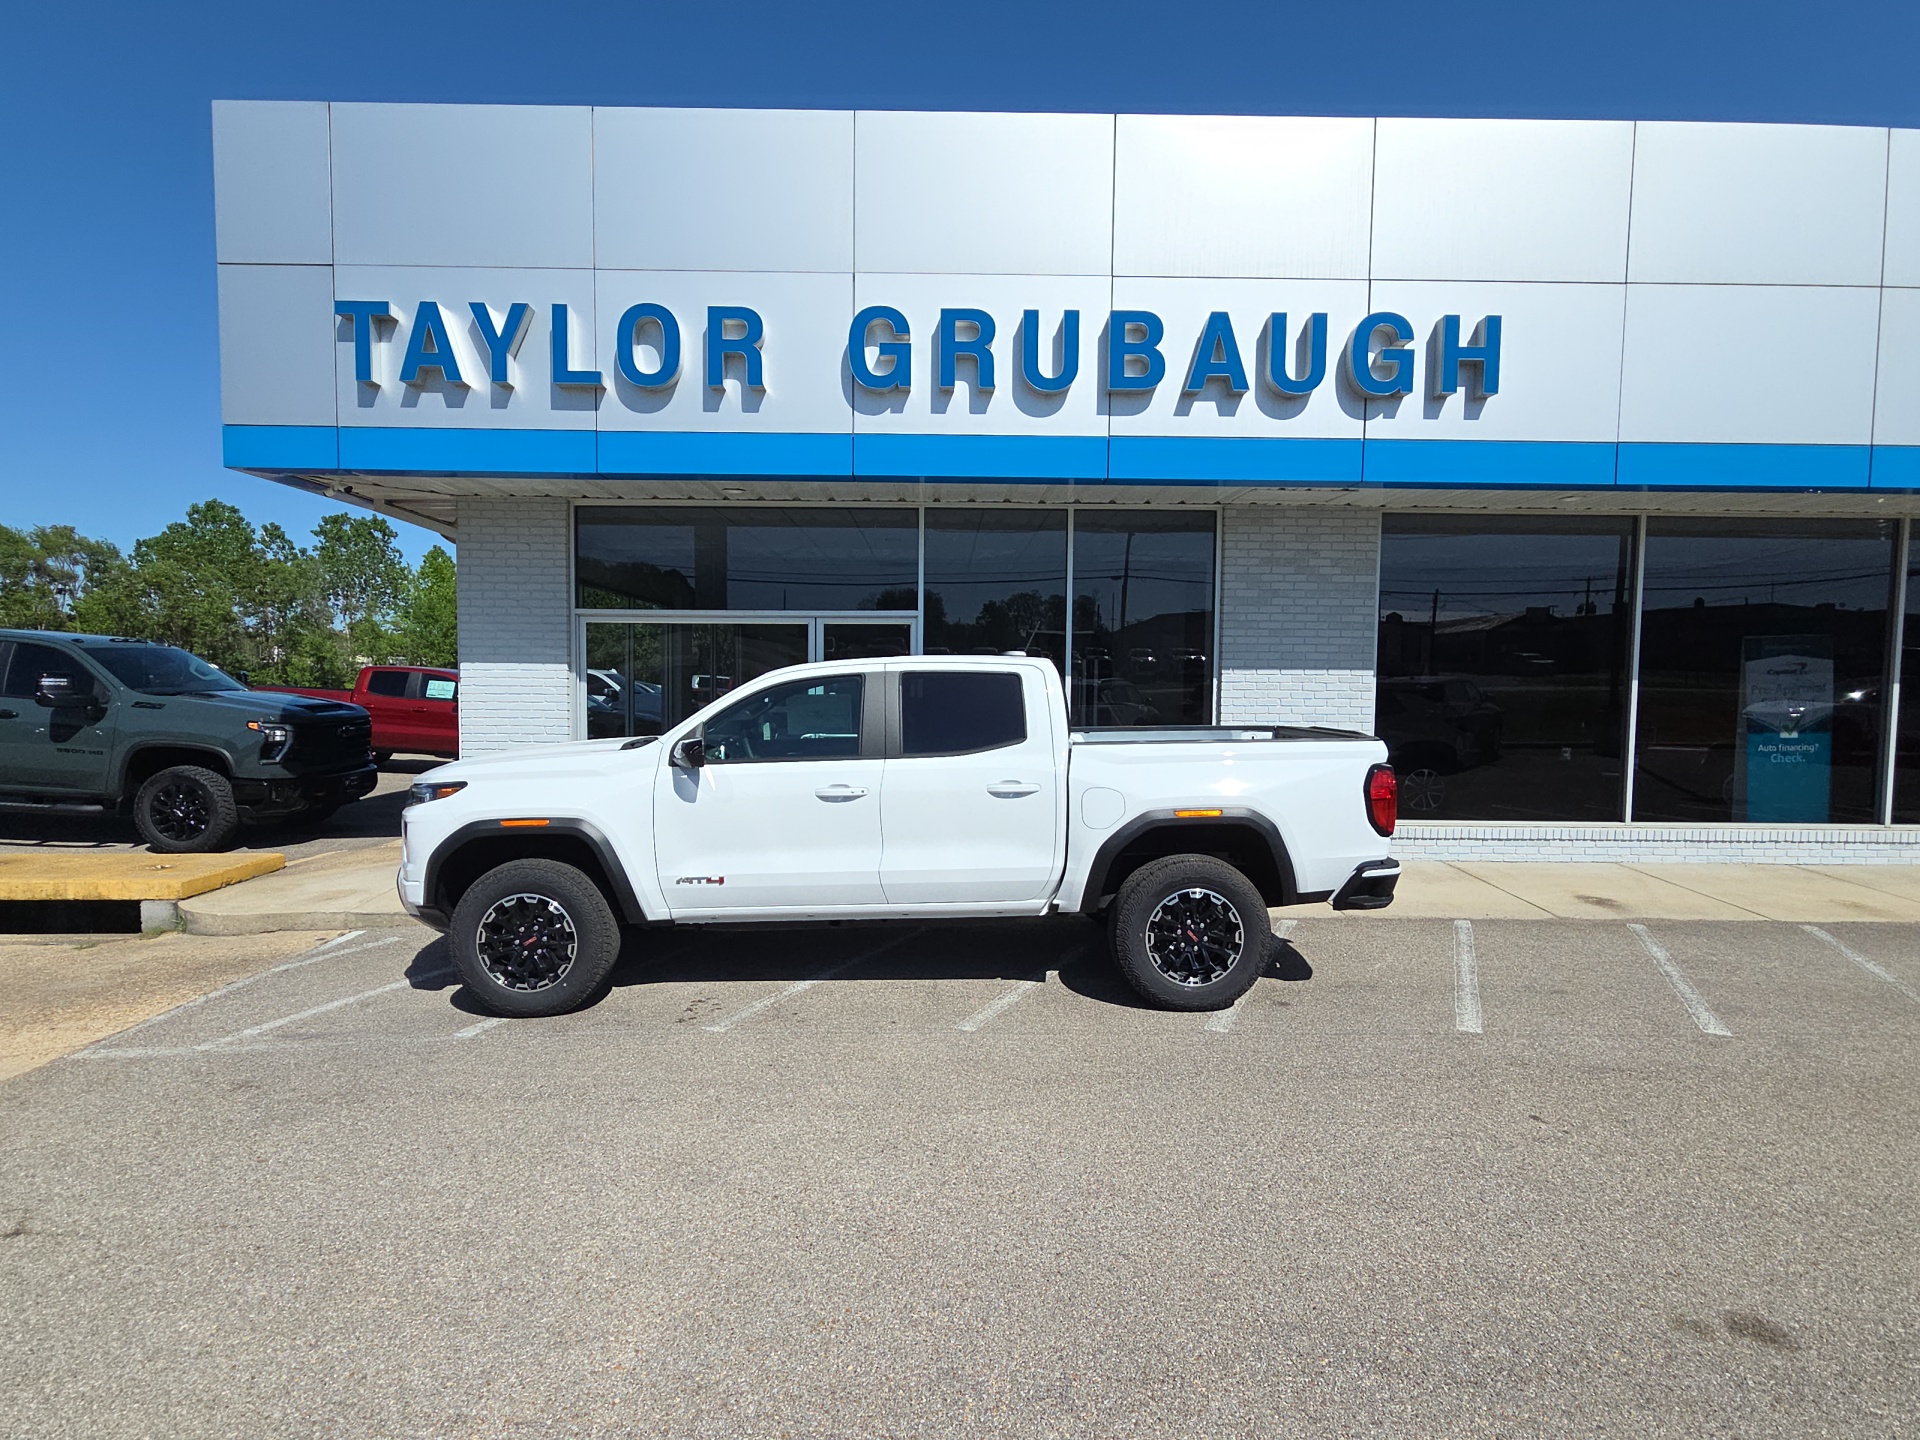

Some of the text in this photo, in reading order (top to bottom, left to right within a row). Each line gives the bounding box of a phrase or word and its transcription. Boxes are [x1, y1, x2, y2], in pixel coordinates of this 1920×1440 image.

[335, 301, 1502, 397] TAYLOR GRUBAUGH
[1758, 743, 1819, 753] Auto financing?
[1770, 753, 1806, 763] Check.
[675, 876, 725, 886] AT4
